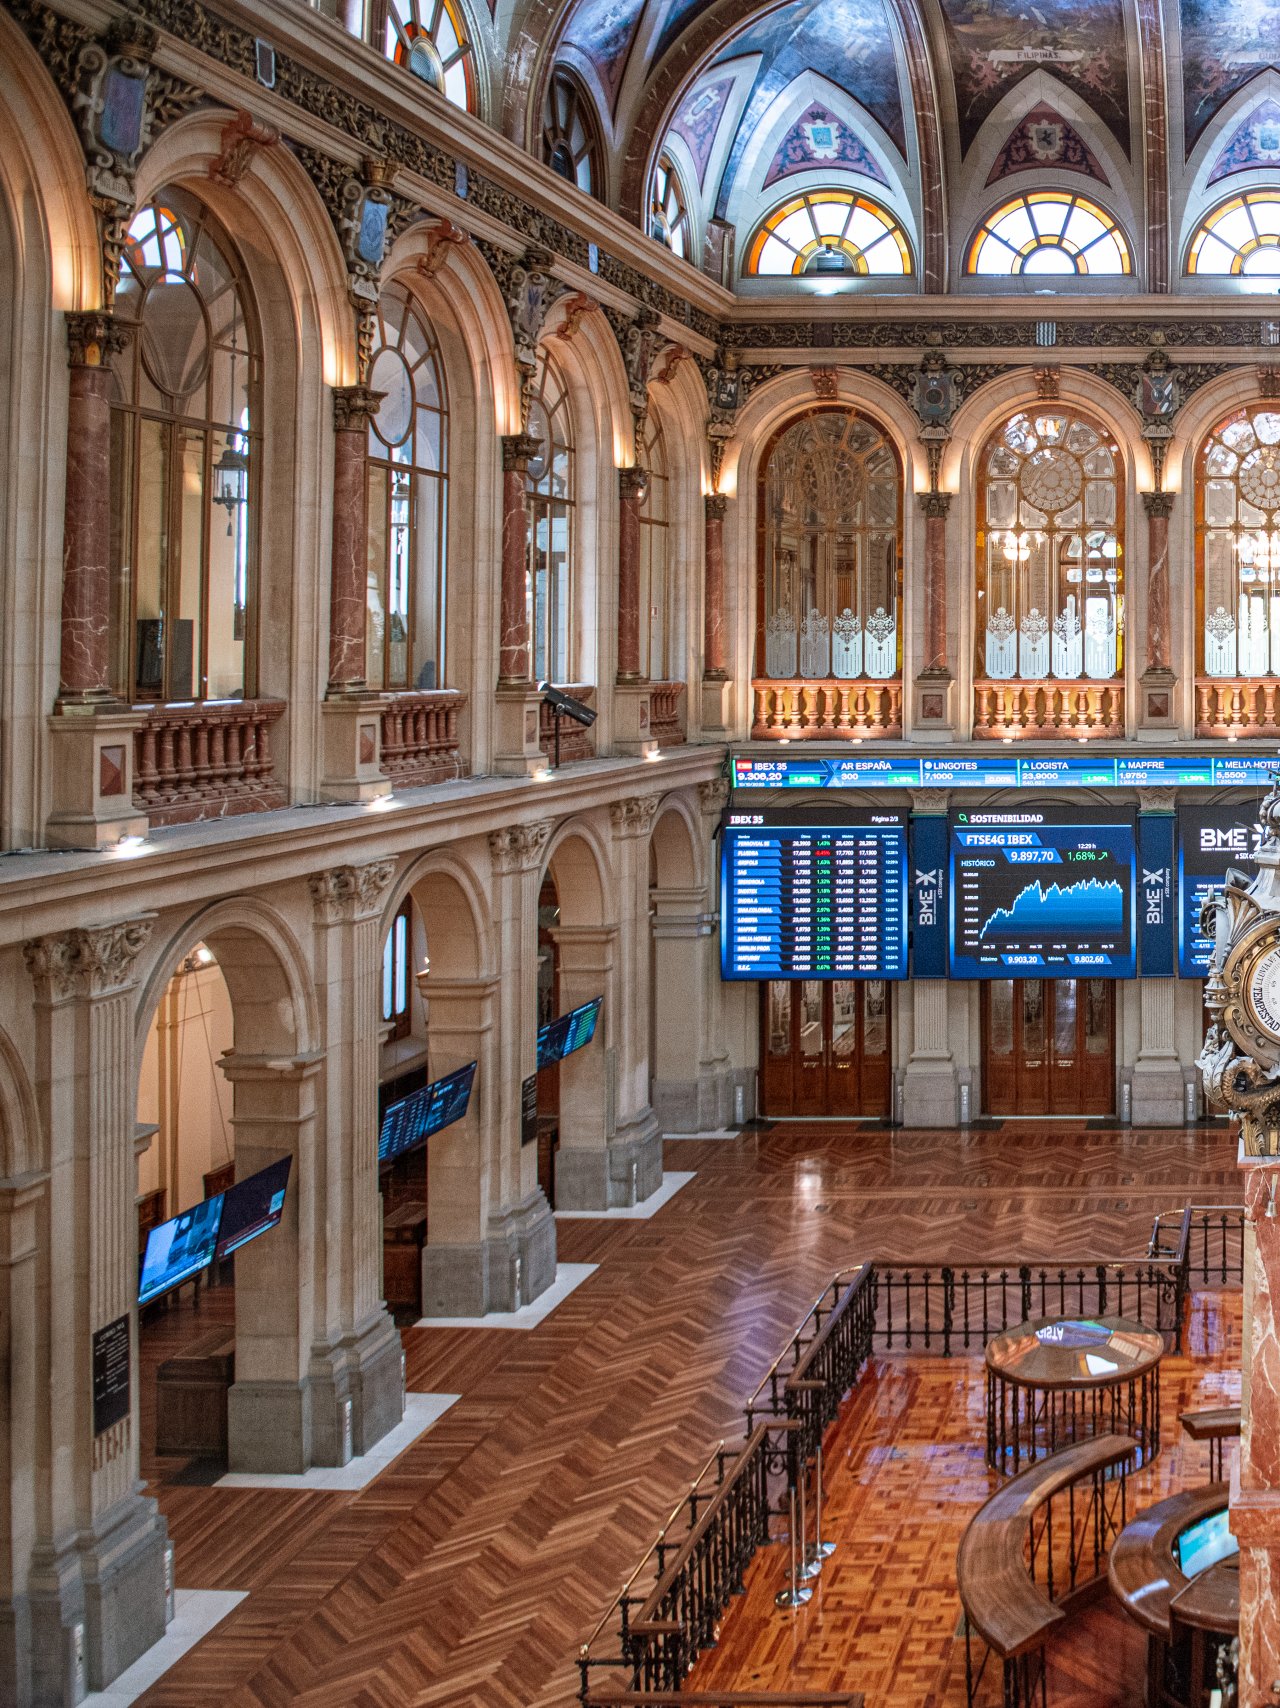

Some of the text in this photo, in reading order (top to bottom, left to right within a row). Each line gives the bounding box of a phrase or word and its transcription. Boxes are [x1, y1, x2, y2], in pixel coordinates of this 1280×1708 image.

[754, 762, 788, 770] IBEX 35
[841, 760, 892, 770] AR ESPAÑA
[933, 762, 978, 770] LINGOTES
[1030, 762, 1069, 770] LOGISTA
[731, 816, 763, 824] IBEX 35
[970, 814, 1043, 823] SOSTENIBILIDAD
[966, 834, 1032, 845] FTSE4G IBEX
[1200, 829, 1247, 847] BME
[1011, 851, 1053, 862] 9.897,70
[1068, 852, 1095, 861] 1,68%
[961, 859, 995, 867] HISTÓRICO
[920, 890, 933, 924] BME
[1146, 889, 1160, 924] BME
[1008, 956, 1037, 964] 9.903,20
[1253, 987, 1280, 1032] TEMPESTAD
